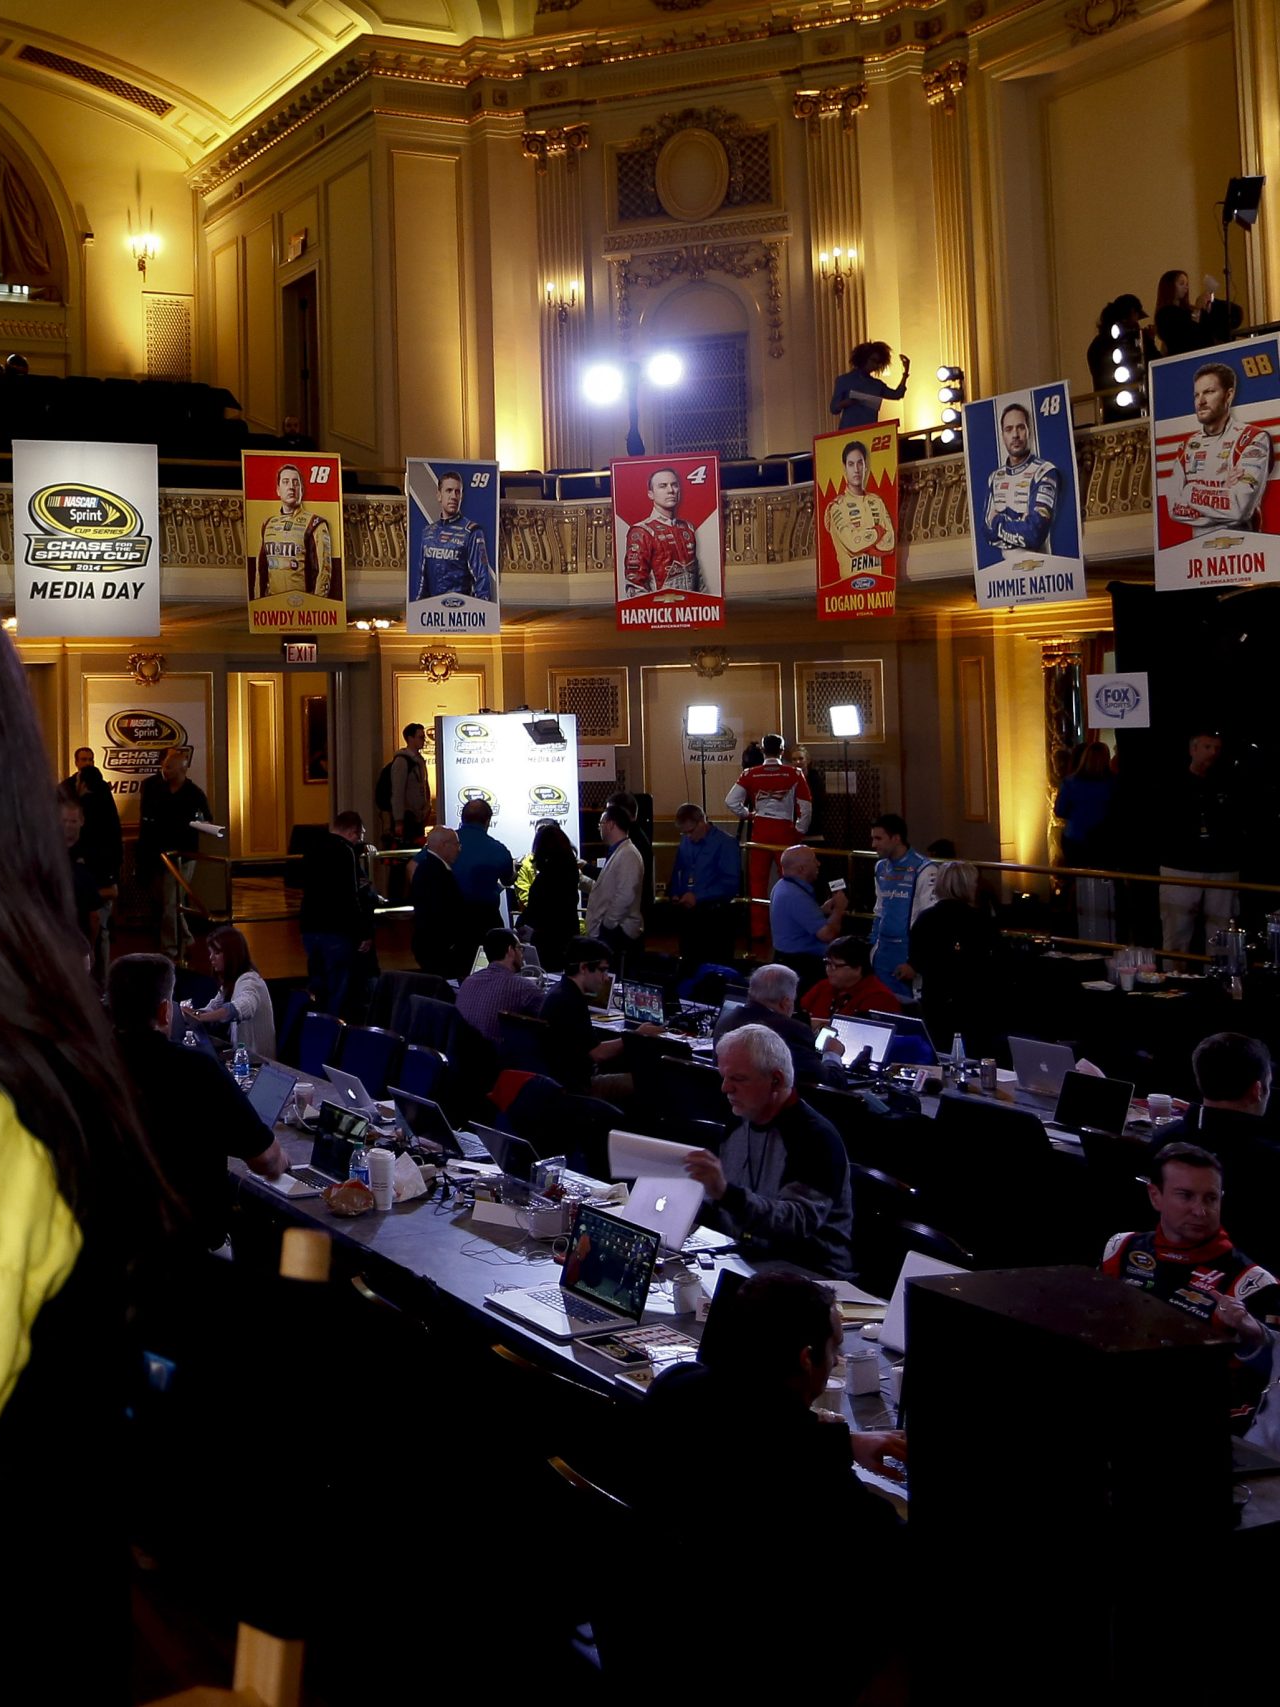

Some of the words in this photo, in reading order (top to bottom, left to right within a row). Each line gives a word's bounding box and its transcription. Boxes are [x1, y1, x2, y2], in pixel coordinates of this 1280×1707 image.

[1241, 353, 1273, 378] 88
[1040, 394, 1060, 417] 48
[871, 435, 891, 452] 22
[310, 465, 331, 484] 18
[471, 472, 490, 488] 99
[687, 466, 707, 484] 4
[63, 496, 97, 508] NASCAR
[69, 508, 103, 523] Sprint
[46, 541, 113, 551] CHASE
[34, 551, 102, 560] SPRINT
[103, 551, 141, 560] CUP
[1187, 559, 1203, 579] JR
[1207, 552, 1265, 577] NATION
[29, 581, 96, 600] MEDIA
[101, 582, 145, 600] DAY
[987, 577, 1026, 599] JIMMIE
[1029, 572, 1074, 594] NATION
[825, 593, 865, 613] LOGANO
[253, 610, 295, 626] ROWDY
[297, 610, 337, 626] NATION
[420, 612, 445, 626] CARL
[448, 612, 486, 627] NATION
[621, 608, 673, 624] HARVICK
[675, 606, 720, 623] NATION
[288, 646, 315, 662] EXIT
[1104, 688, 1130, 702] FOX
[129, 719, 155, 727] NASCAR
[133, 728, 159, 738] Sprint
